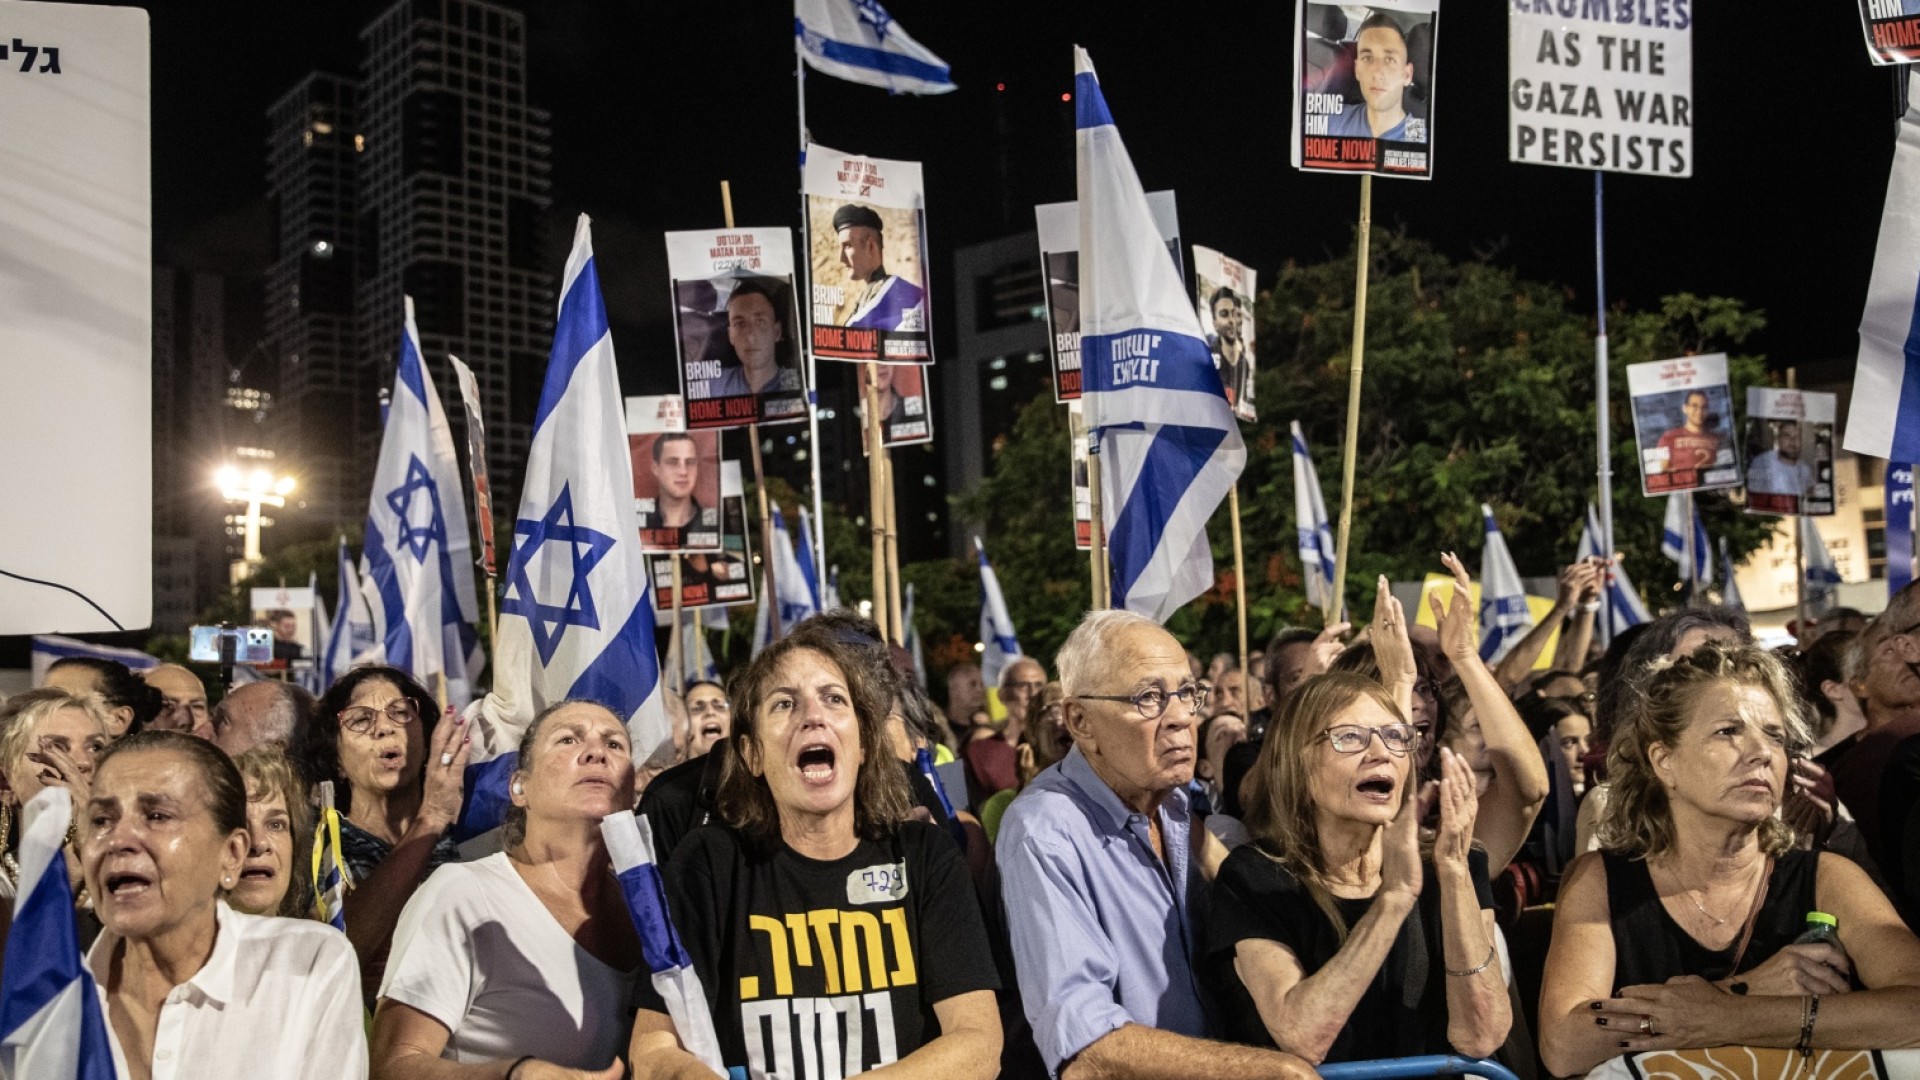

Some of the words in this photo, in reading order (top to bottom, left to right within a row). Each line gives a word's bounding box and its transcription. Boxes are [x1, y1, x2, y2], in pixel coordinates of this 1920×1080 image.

[1536, 29, 1581, 67] AS
[1597, 35, 1665, 76] THE
[1305, 93, 1344, 115] BRING
[1512, 78, 1602, 118] GAZA
[1614, 88, 1691, 127] WAR
[1305, 115, 1329, 136] HIM
[1305, 138, 1339, 160] HOME
[1341, 141, 1377, 162] NOW!
[1517, 124, 1686, 174] PERSISTS
[813, 285, 844, 306] BRING
[813, 305, 834, 326] HIM
[814, 327, 844, 349] HOME
[846, 329, 878, 351] NOW!
[1056, 332, 1081, 351] BRI
[686, 360, 722, 380] BRING
[1058, 351, 1081, 371] HIM
[687, 380, 711, 400] HIM
[689, 401, 722, 419] HOME
[725, 397, 758, 417] NOW!
[862, 870, 905, 892] 729
[739, 907, 917, 1000] נחזיר.
